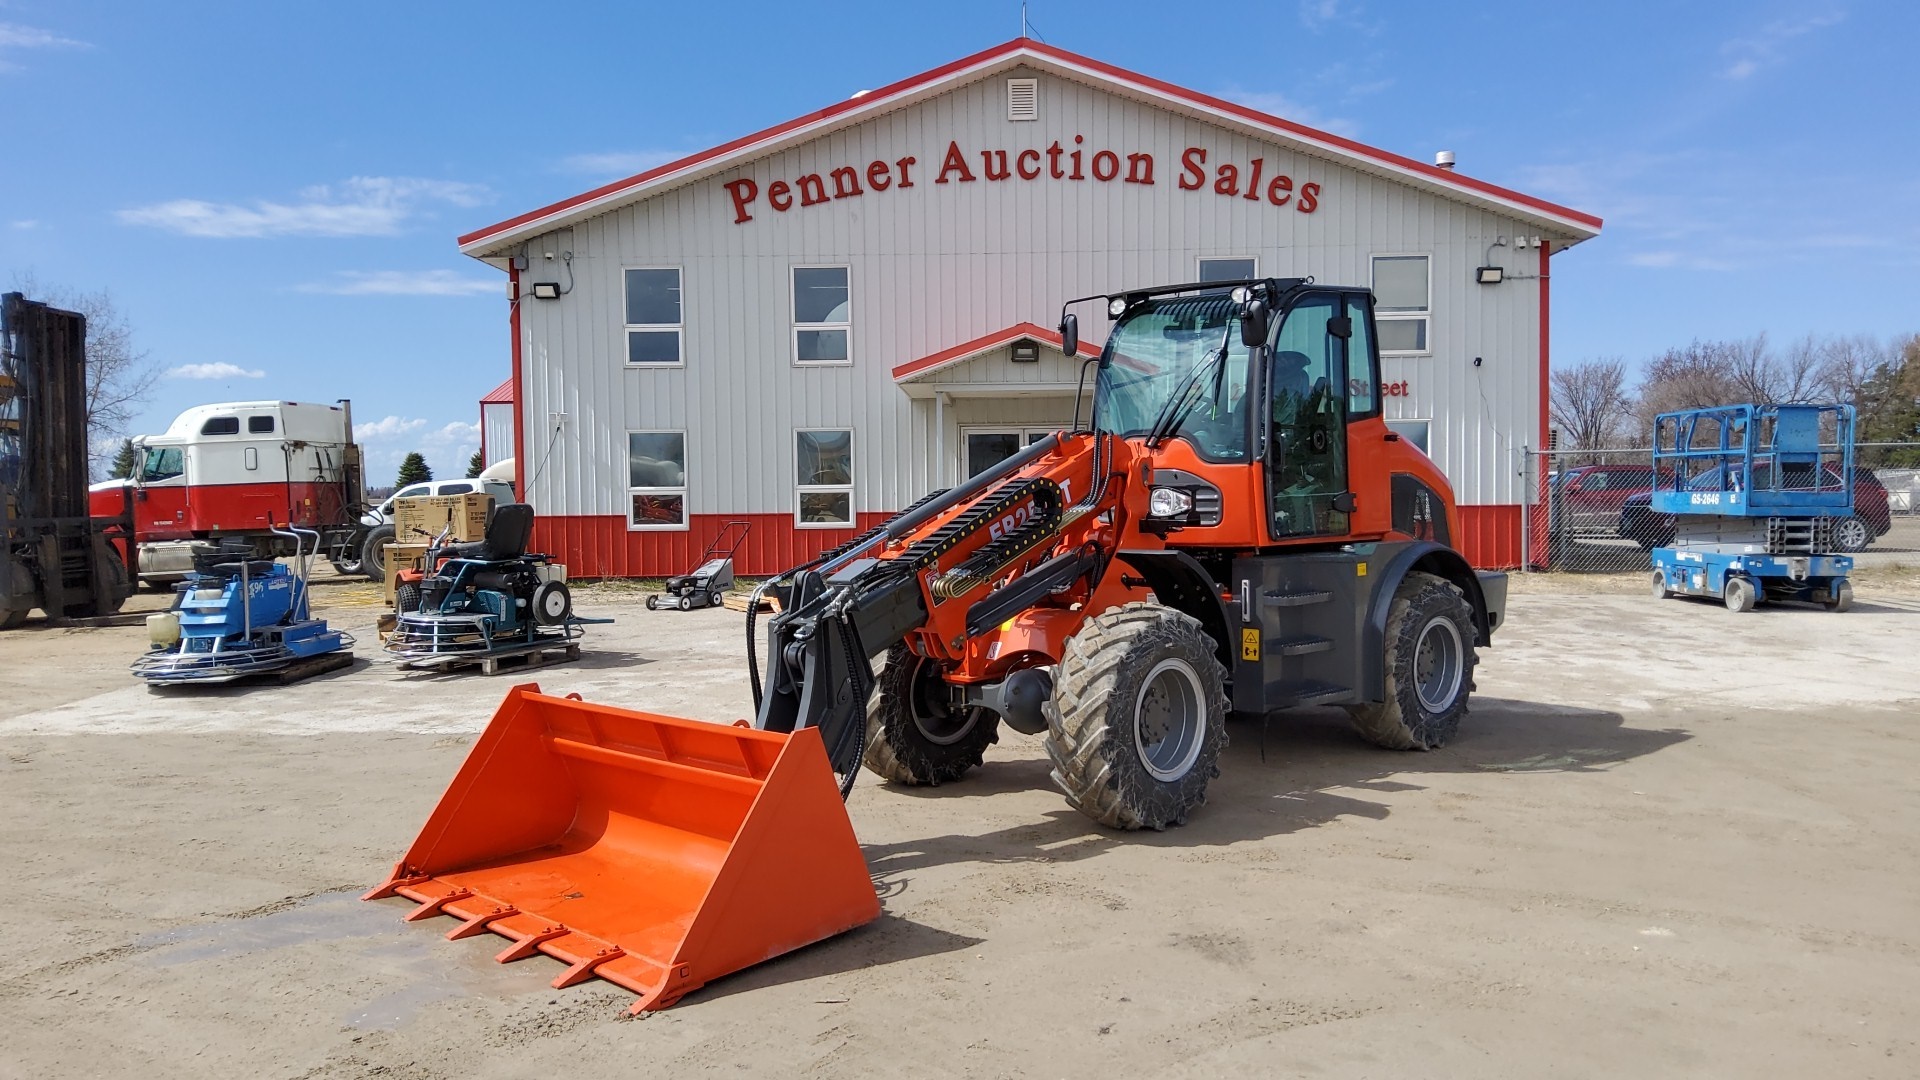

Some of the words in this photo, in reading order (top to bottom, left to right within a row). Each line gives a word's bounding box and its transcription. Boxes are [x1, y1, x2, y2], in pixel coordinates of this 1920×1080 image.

[725, 155, 916, 224] Penner
[935, 135, 1155, 185] Auction
[1178, 146, 1321, 214] Sales
[1349, 378, 1409, 397] Steet
[1691, 493, 1720, 505] GS-2646
